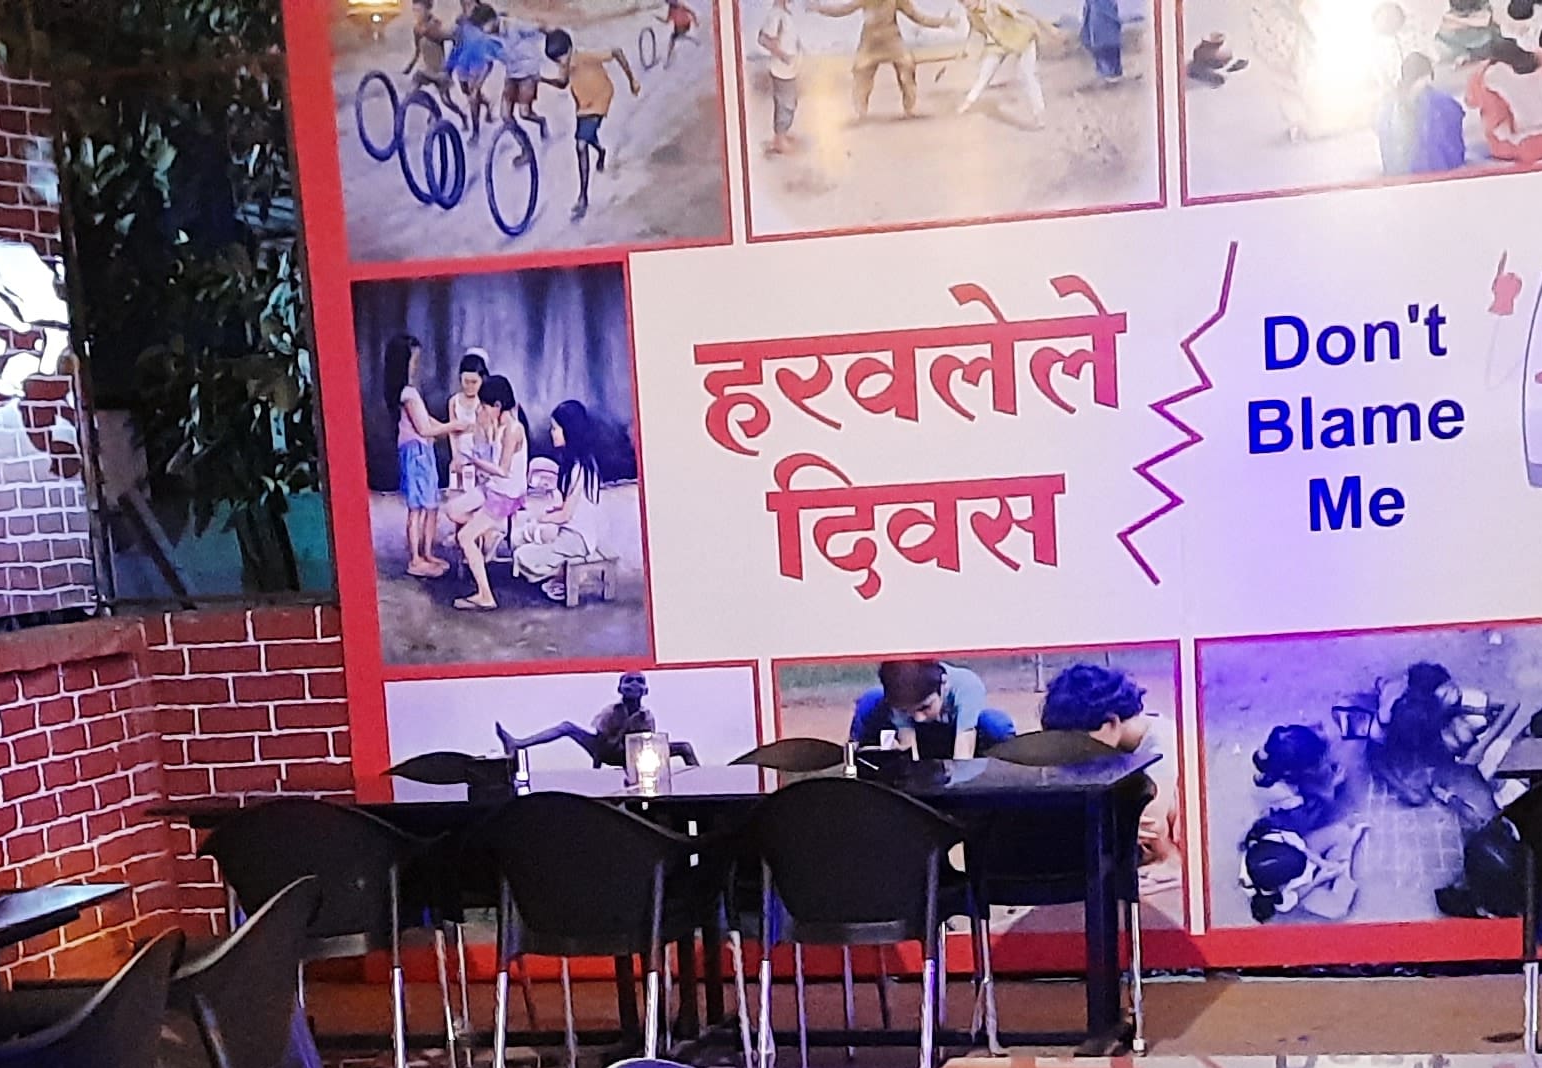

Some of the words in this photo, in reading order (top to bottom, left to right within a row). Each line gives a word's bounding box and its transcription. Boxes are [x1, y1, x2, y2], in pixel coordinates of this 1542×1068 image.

[695, 277, 1126, 457] हरवलेले
[1264, 303, 1448, 371] Don't
[1247, 396, 1465, 455] Blame
[767, 454, 1065, 598] दिवस
[1309, 475, 1406, 532] Me
